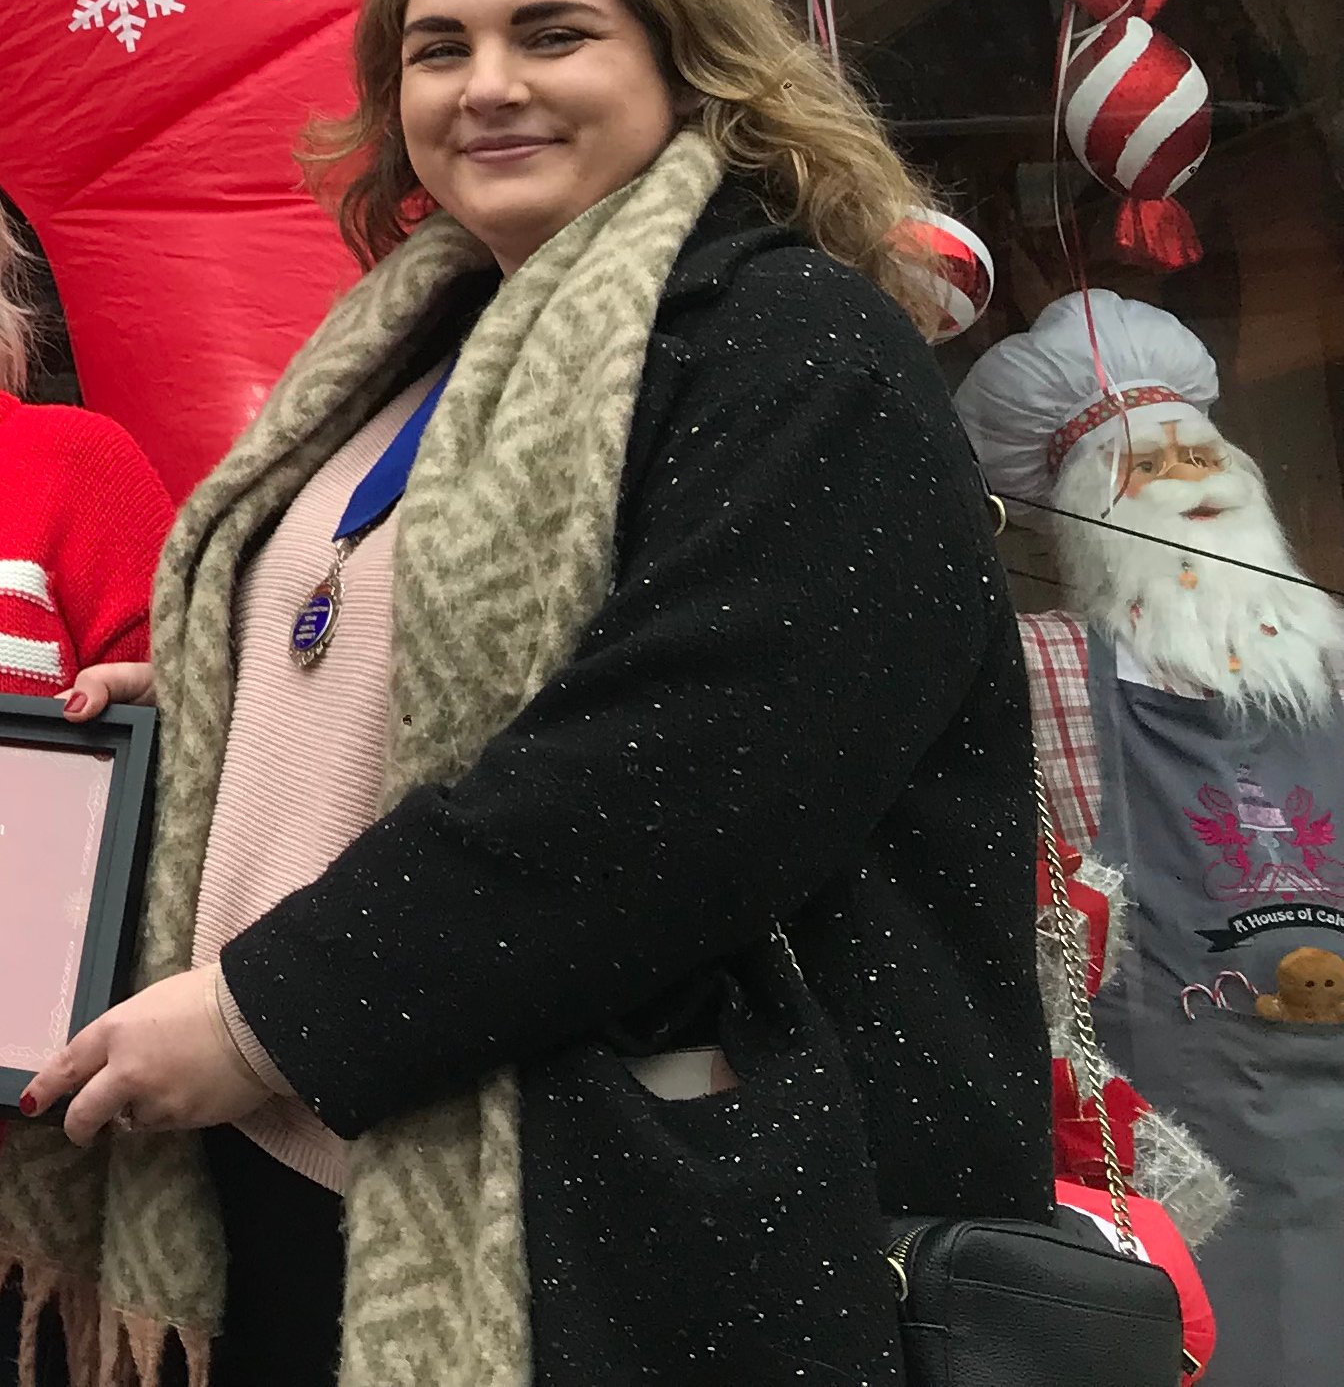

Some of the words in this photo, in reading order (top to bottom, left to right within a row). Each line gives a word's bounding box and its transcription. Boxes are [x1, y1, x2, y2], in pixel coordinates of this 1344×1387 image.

[1233, 919, 1248, 933] A
[1246, 911, 1295, 929] House
[1297, 907, 1313, 921] of
[1316, 910, 1344, 927] Cak
